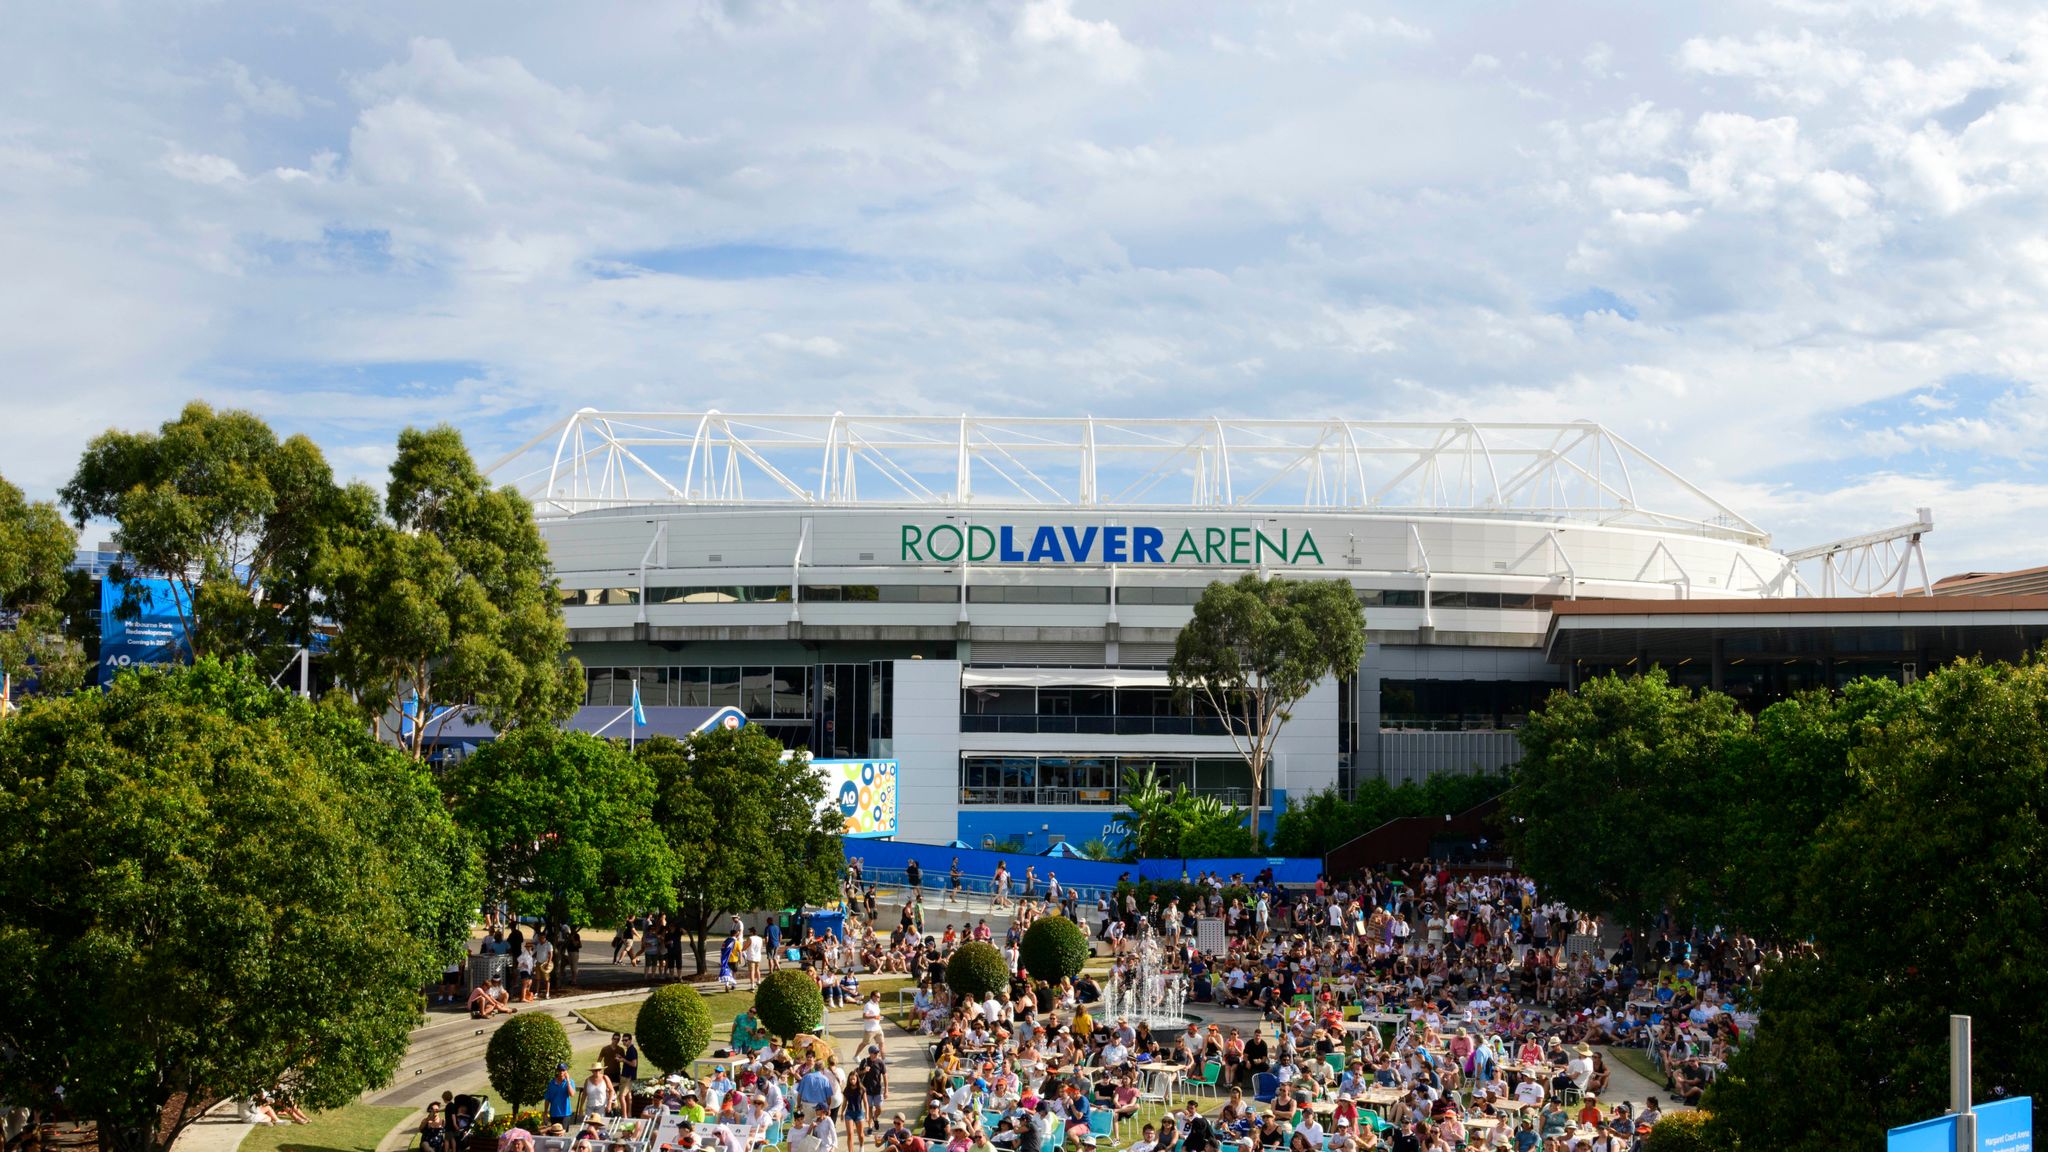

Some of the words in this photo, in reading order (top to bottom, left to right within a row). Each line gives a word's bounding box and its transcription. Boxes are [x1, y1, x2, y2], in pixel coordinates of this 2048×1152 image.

[901, 524, 996, 562] ROD
[1000, 526, 1165, 562] LAVER
[1170, 528, 1324, 564] ARENA
[1985, 1135, 2004, 1146] Margaret
[2005, 1132, 2017, 1142] Court
[2017, 1130, 2029, 1138] Arena
